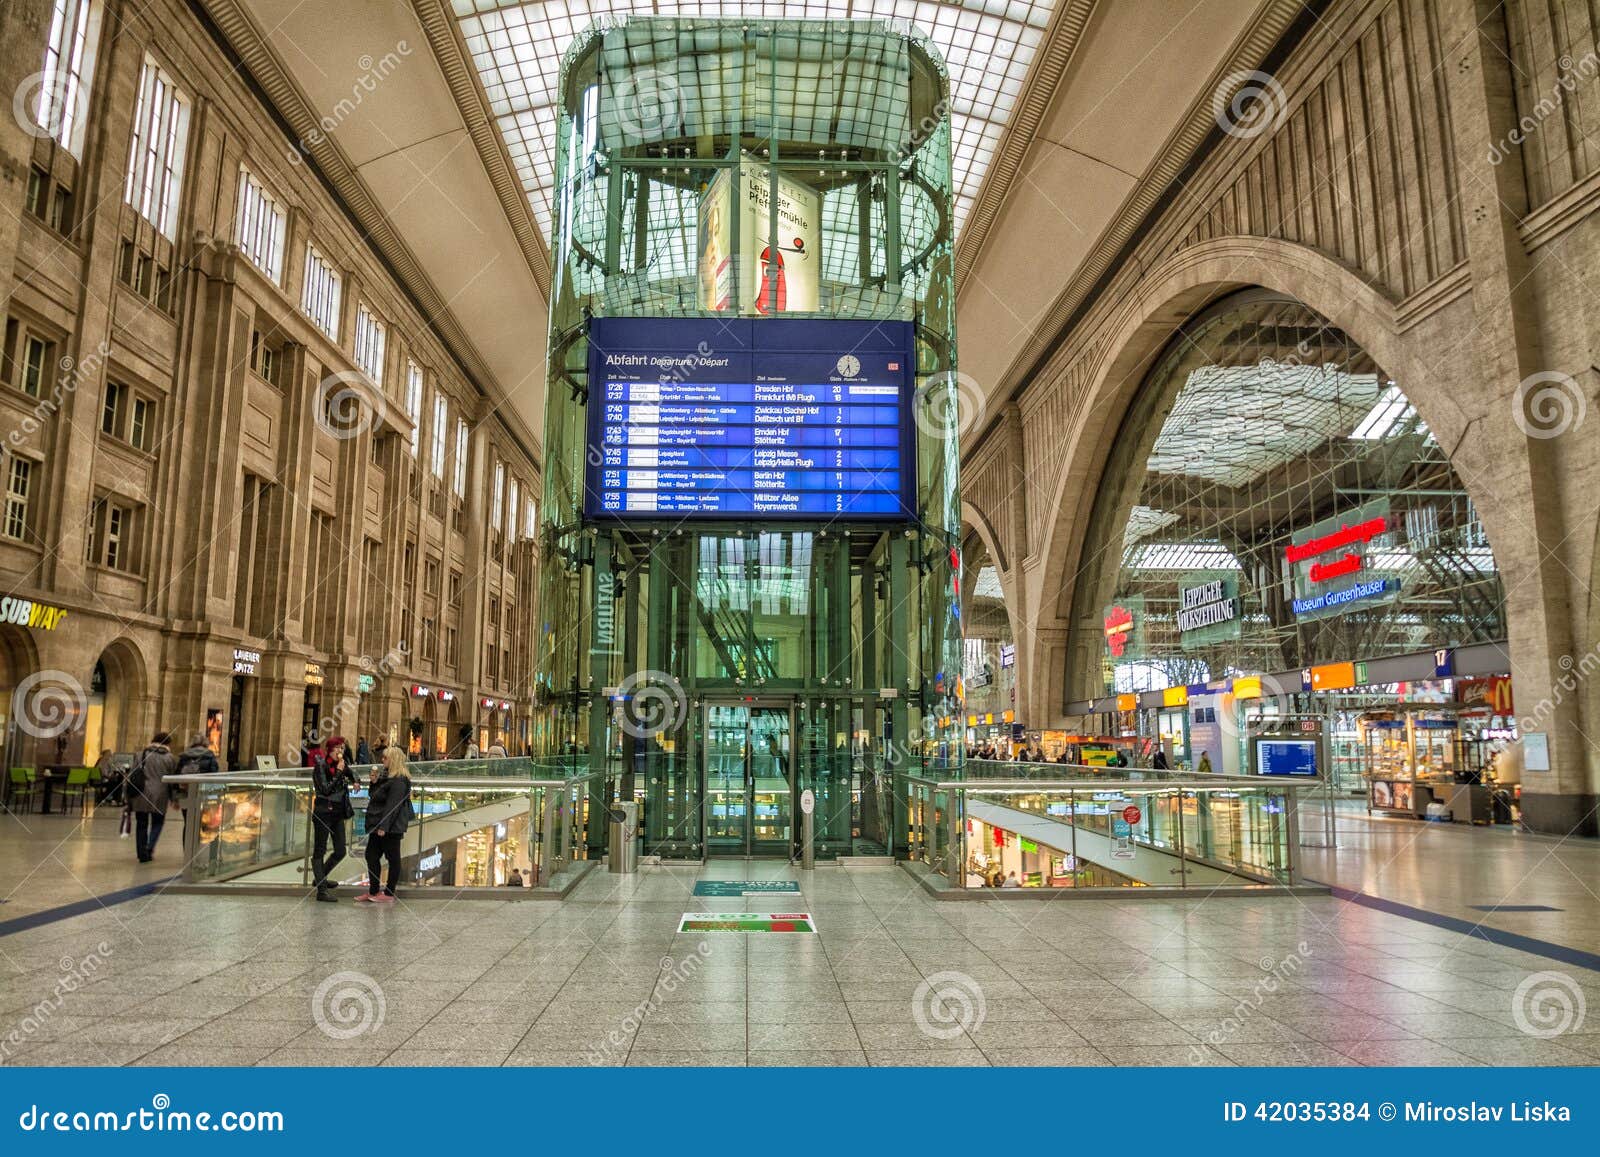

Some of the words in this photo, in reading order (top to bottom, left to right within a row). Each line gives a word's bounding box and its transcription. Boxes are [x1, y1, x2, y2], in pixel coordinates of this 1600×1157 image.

[606, 354, 648, 366] Abfahrt
[650, 357, 692, 368] Departure
[700, 356, 729, 367] Départ
[755, 385, 781, 393] Dresden
[754, 450, 776, 459] Leipzig
[836, 459, 842, 467] 2
[836, 494, 842, 502] 2
[836, 503, 842, 511] 2
[1181, 579, 1223, 610] LEIPZIGER
[1293, 597, 1325, 614] Museum
[1325, 580, 1385, 606] Gunzenhauser
[0, 597, 68, 632] SUBWAY
[1176, 598, 1234, 633] VOLKSZEITUNG
[1435, 650, 1446, 667] 17
[1301, 667, 1312, 684] 16
